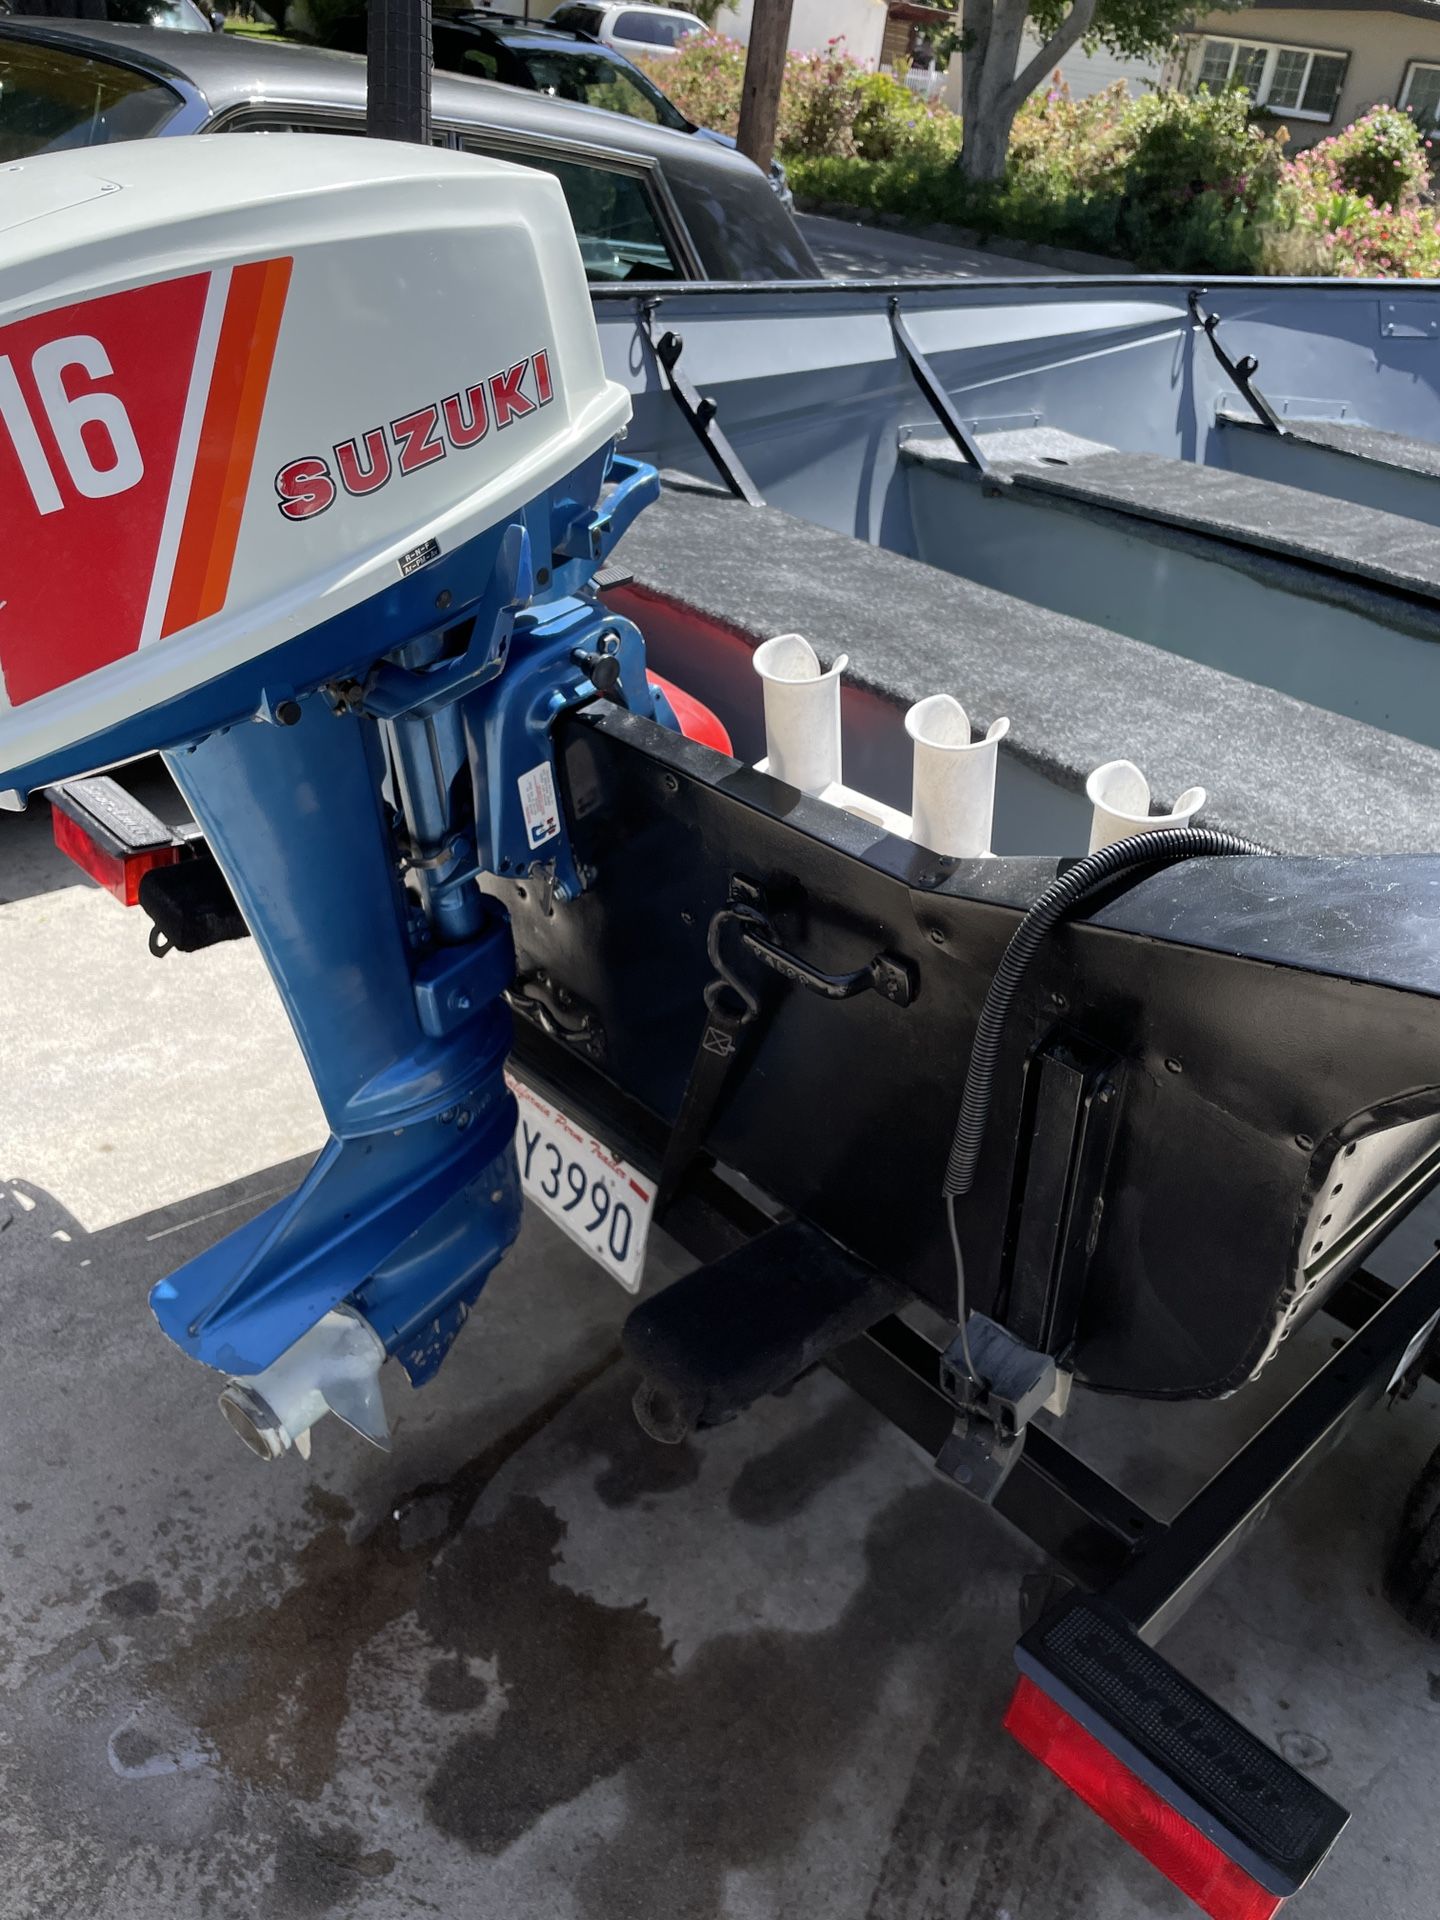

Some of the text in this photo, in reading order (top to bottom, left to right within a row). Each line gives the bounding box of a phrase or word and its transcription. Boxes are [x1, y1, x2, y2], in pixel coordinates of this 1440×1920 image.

[0, 334, 144, 515] 16
[275, 348, 554, 522] SUZUKI
[506, 1078, 550, 1117] alifornia
[590, 1140, 626, 1179] Trailer
[522, 1120, 632, 1262] Y3990
